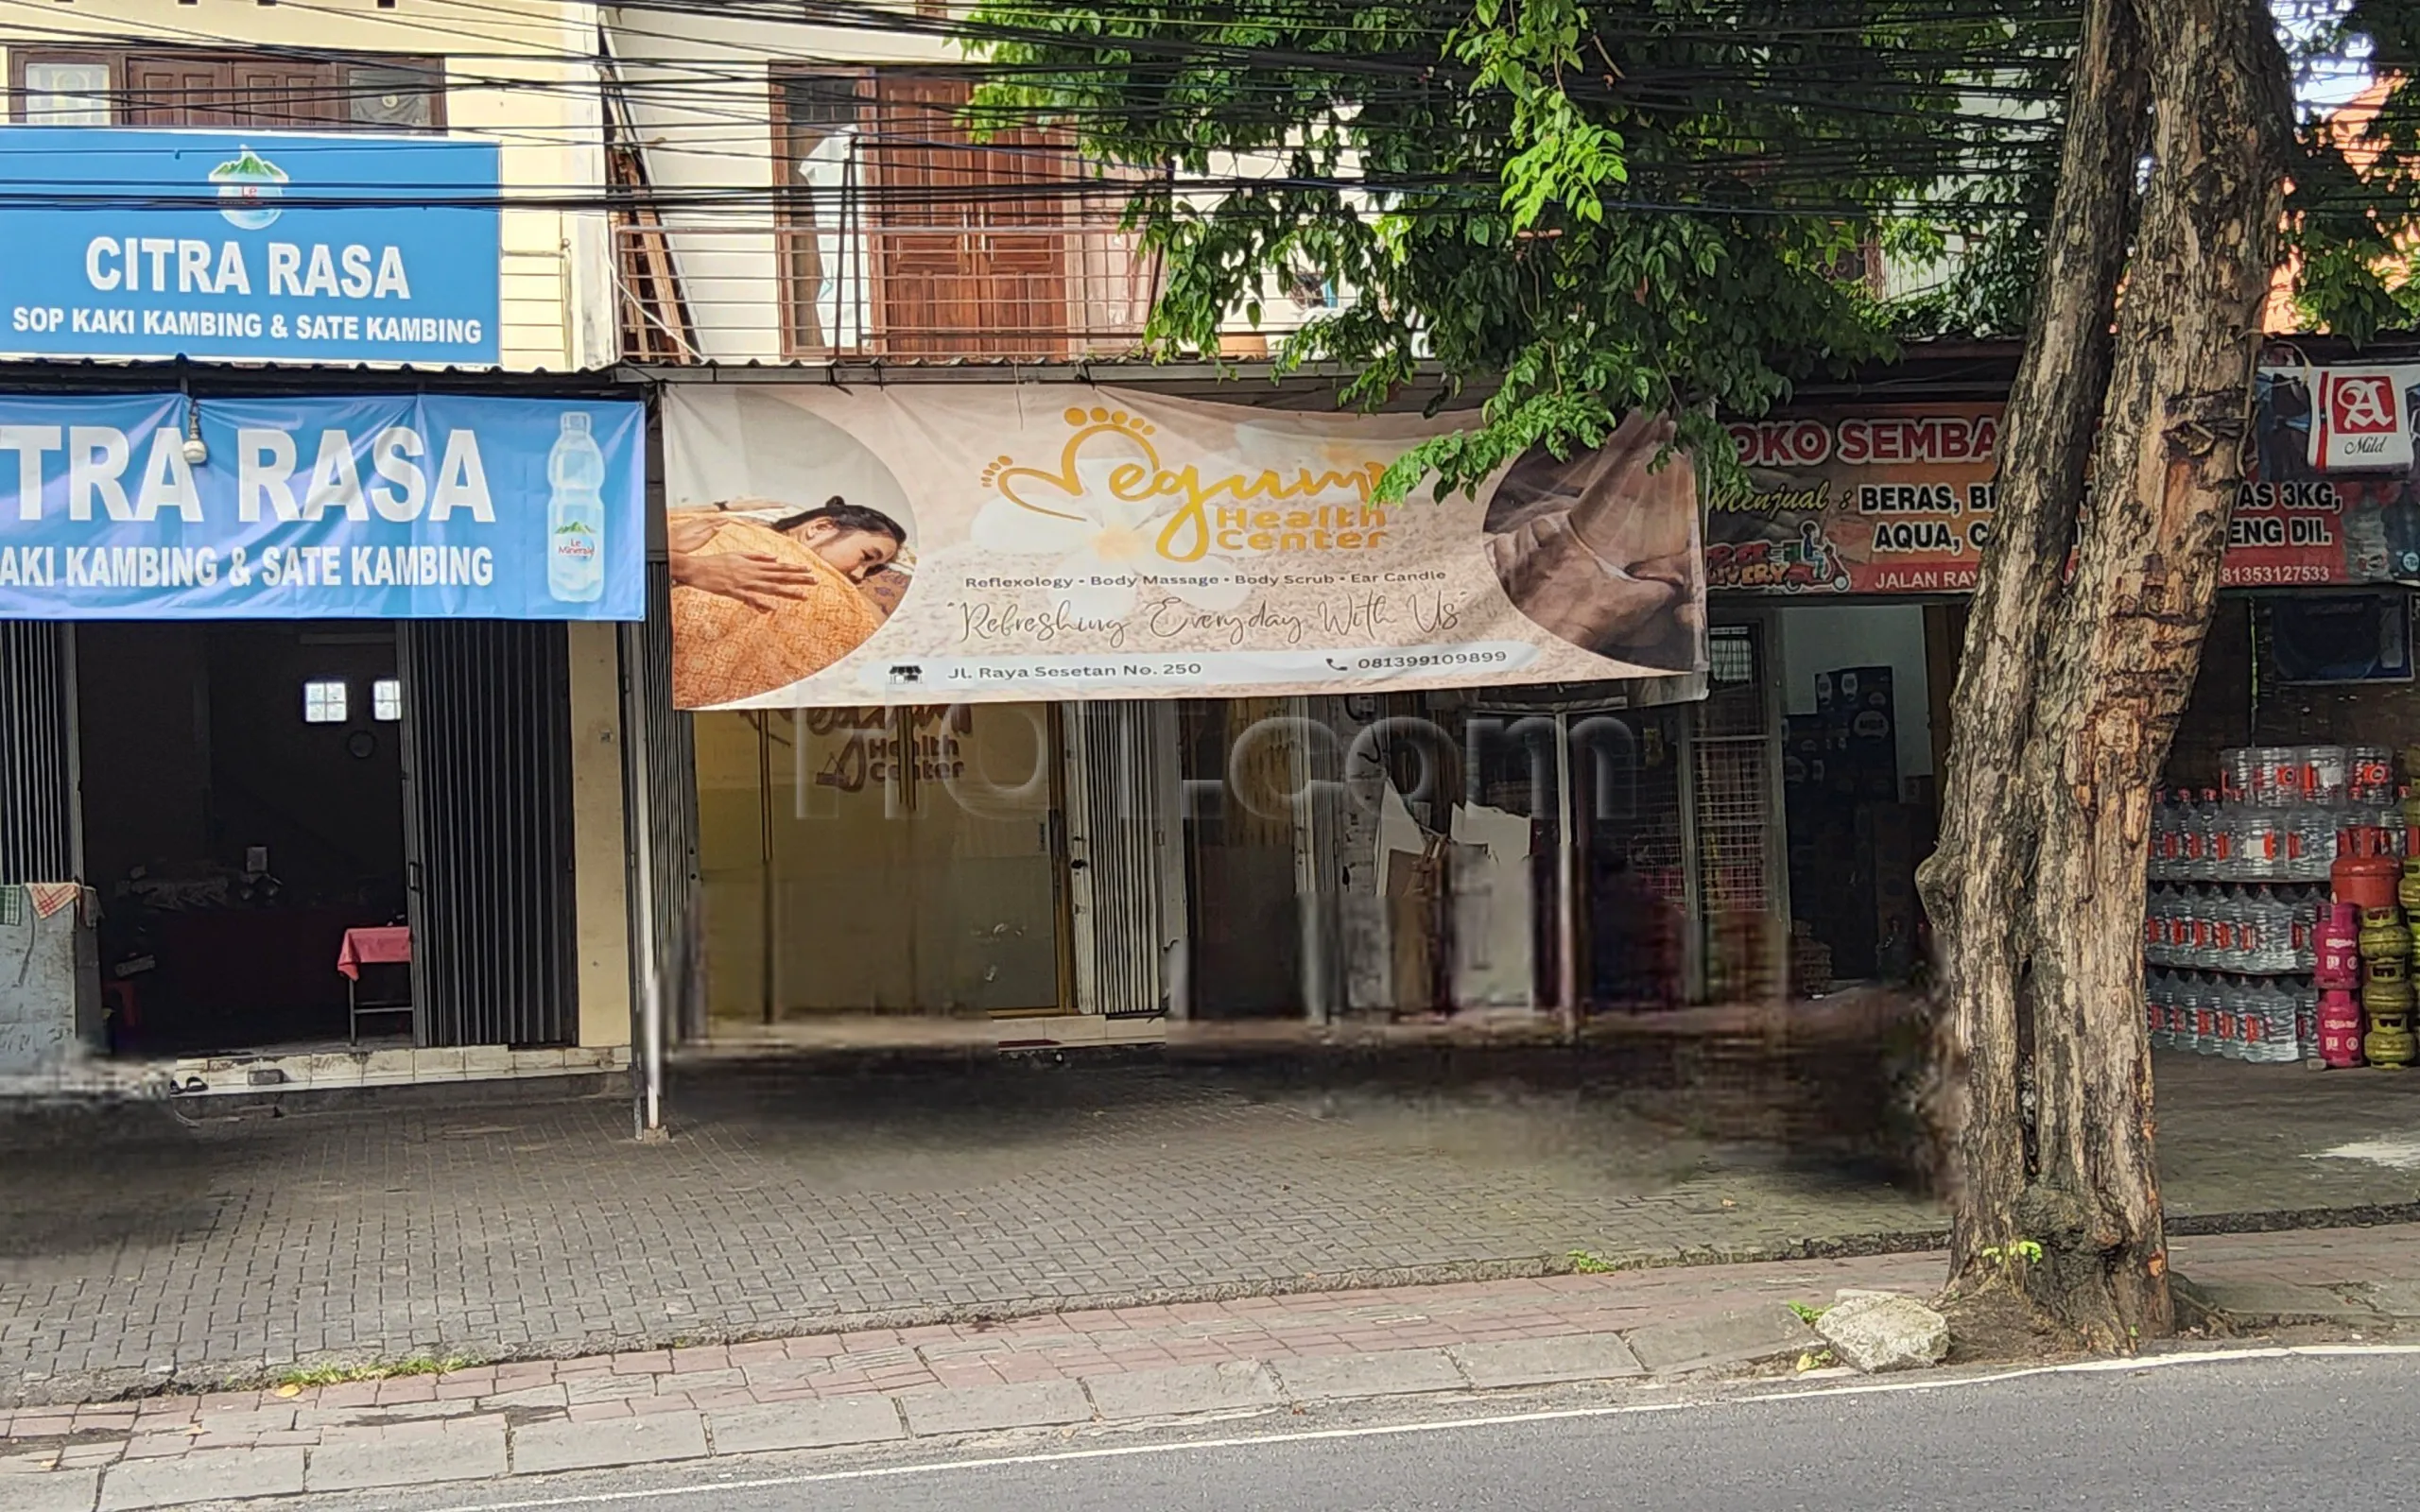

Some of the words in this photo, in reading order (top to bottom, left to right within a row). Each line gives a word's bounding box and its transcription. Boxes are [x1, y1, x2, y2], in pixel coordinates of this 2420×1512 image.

[87, 236, 252, 295] CITRA
[268, 243, 411, 301] RASA
[12, 307, 64, 334] SOP
[71, 308, 135, 335] KAKI
[143, 310, 263, 338] KAMBING
[270, 314, 289, 339] &
[296, 314, 359, 341] SATE
[365, 317, 482, 344] KAMBING
[1727, 420, 1832, 466] OKO
[2344, 436, 2389, 455] Mild
[237, 427, 496, 524] RASA
[1709, 480, 1831, 520] Menjual
[1858, 483, 1962, 518] BERAS,
[2279, 481, 2343, 514] 3KG,
[1216, 505, 1387, 529] Health
[1216, 529, 1389, 551] Center
[1873, 522, 1963, 556] AQUA,
[65, 546, 217, 588] KAMBING
[228, 548, 251, 588] &
[262, 546, 341, 588] SATE
[351, 545, 493, 588] KAMBING
[965, 576, 1074, 590] Reflexology
[1091, 576, 1137, 588] Body
[1143, 575, 1219, 587] Massage
[1235, 575, 1277, 586] Body
[1284, 574, 1335, 585] Scrub
[1351, 573, 1379, 583] Ear
[1384, 571, 1446, 583] Candle
[1875, 571, 1937, 589] JALAN
[1145, 596, 1302, 645] Everyday
[1317, 590, 1397, 640] With
[948, 667, 972, 679] Jl.
[979, 666, 1029, 680] Raya
[1034, 665, 1116, 678] Sesetan
[1123, 664, 1158, 677] No.
[1163, 663, 1202, 675] 250
[1357, 651, 1508, 670] 081399109899
